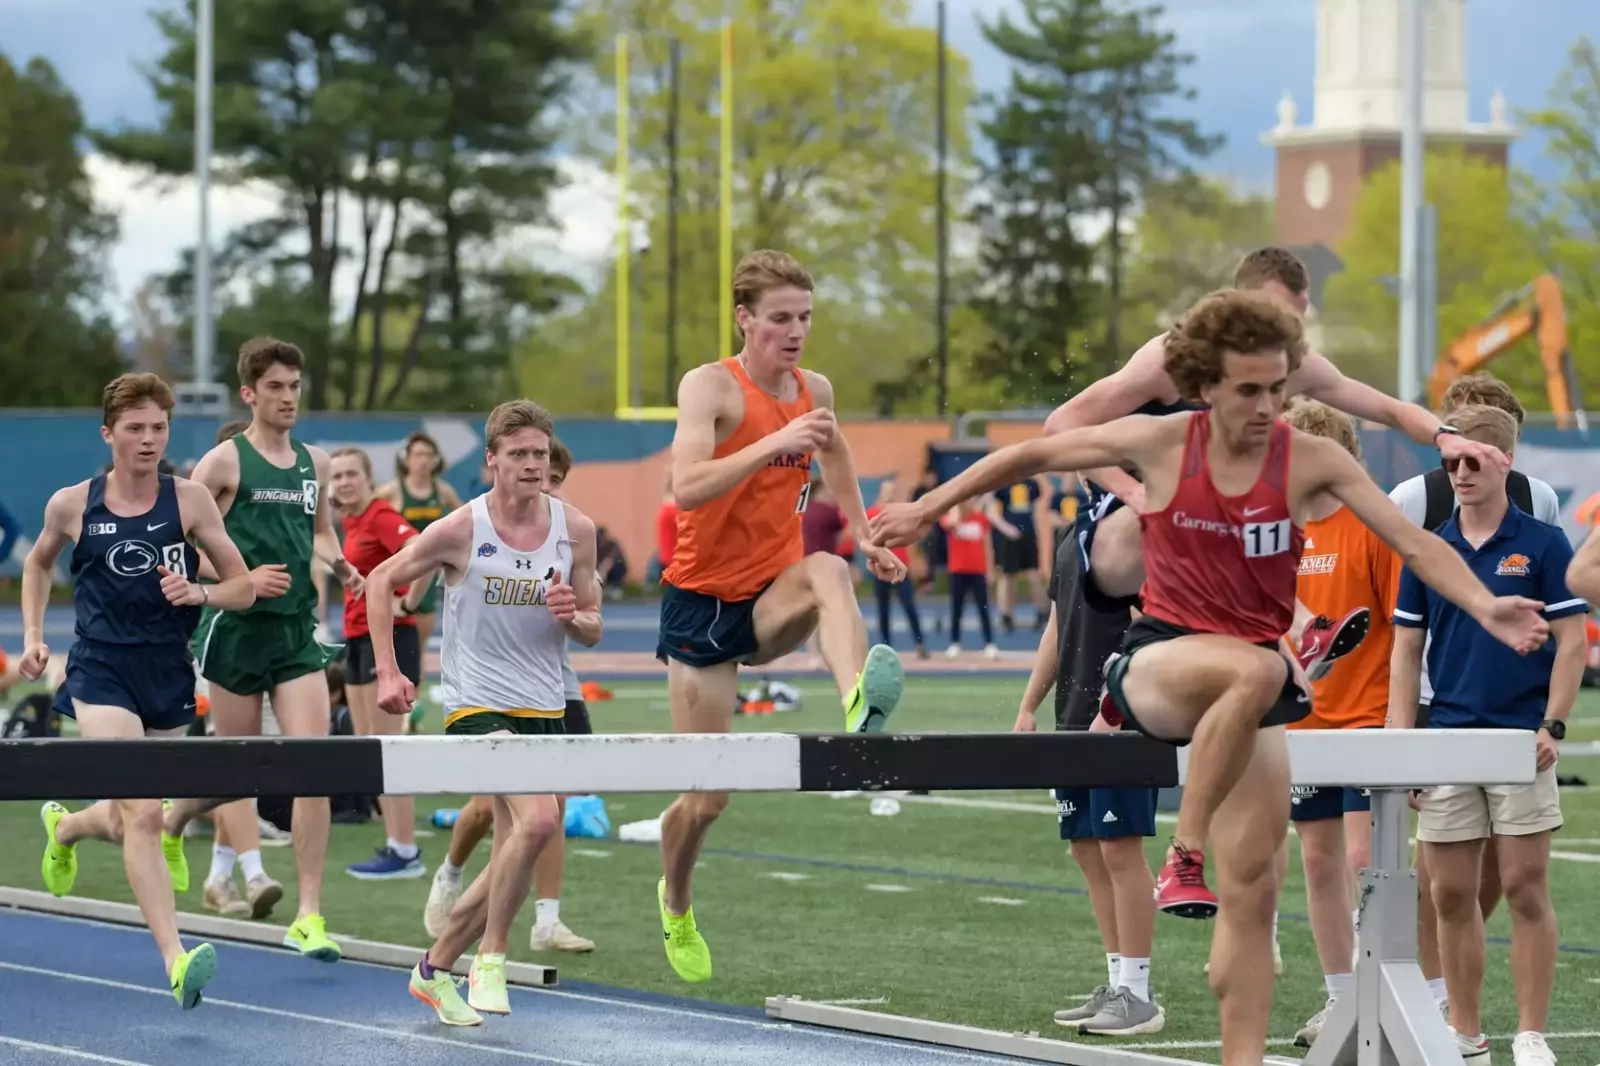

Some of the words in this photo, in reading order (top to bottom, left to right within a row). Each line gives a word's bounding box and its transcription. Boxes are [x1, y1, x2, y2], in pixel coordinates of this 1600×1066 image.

[252, 489, 304, 503] BINGHAMT
[306, 482, 317, 512] 3
[1248, 523, 1281, 555] 11
[167, 546, 184, 576] 8
[483, 576, 548, 606] SIEN
